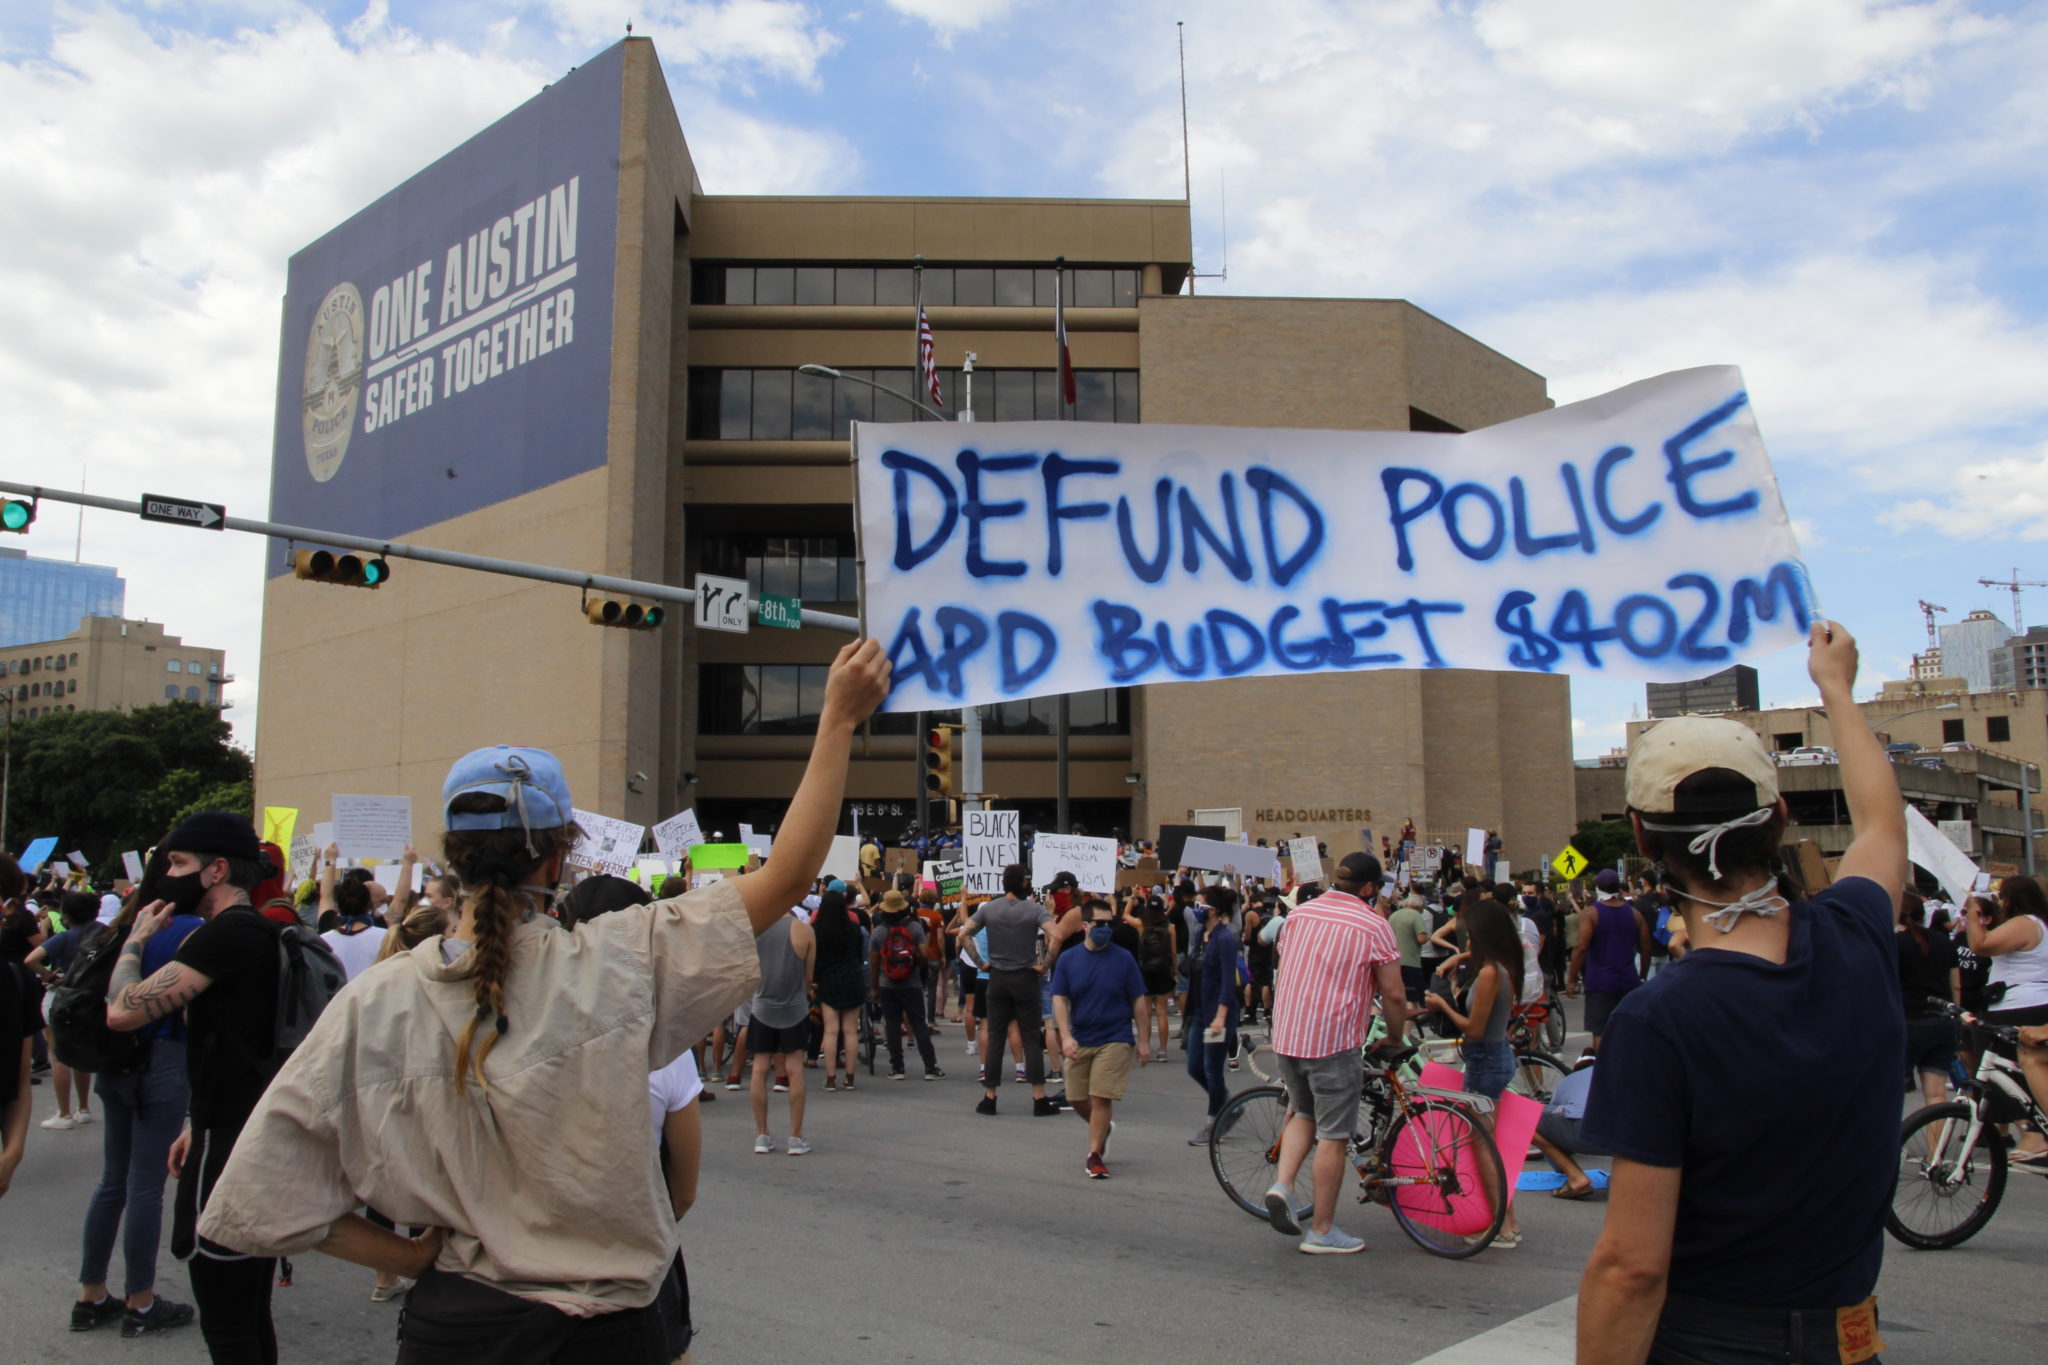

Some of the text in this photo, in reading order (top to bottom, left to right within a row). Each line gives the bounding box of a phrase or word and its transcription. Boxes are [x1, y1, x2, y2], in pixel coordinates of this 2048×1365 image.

[370, 175, 579, 361] ONE AUSTIN
[364, 288, 575, 433] SAFER TOGETHER
[312, 405, 347, 434] POLICE
[880, 390, 1761, 588] DEFUND POLICE
[150, 503, 200, 519] ONE WAY
[759, 598, 801, 622] E 8th ST
[722, 616, 742, 627] ONLY
[786, 618, 801, 629] 700
[881, 560, 1814, 702] APD BUDGET $402M
[891, 804, 903, 816] St.
[1256, 809, 1372, 822] HEADQUARTERS
[656, 821, 681, 837] UNTIL
[970, 812, 1018, 839] BLACK
[1039, 835, 1108, 851] TOLERATING
[965, 843, 1018, 868] LIVES
[1060, 851, 1098, 863] RACISM
[966, 872, 1004, 892] MATT
[1053, 866, 1106, 887] RISM
